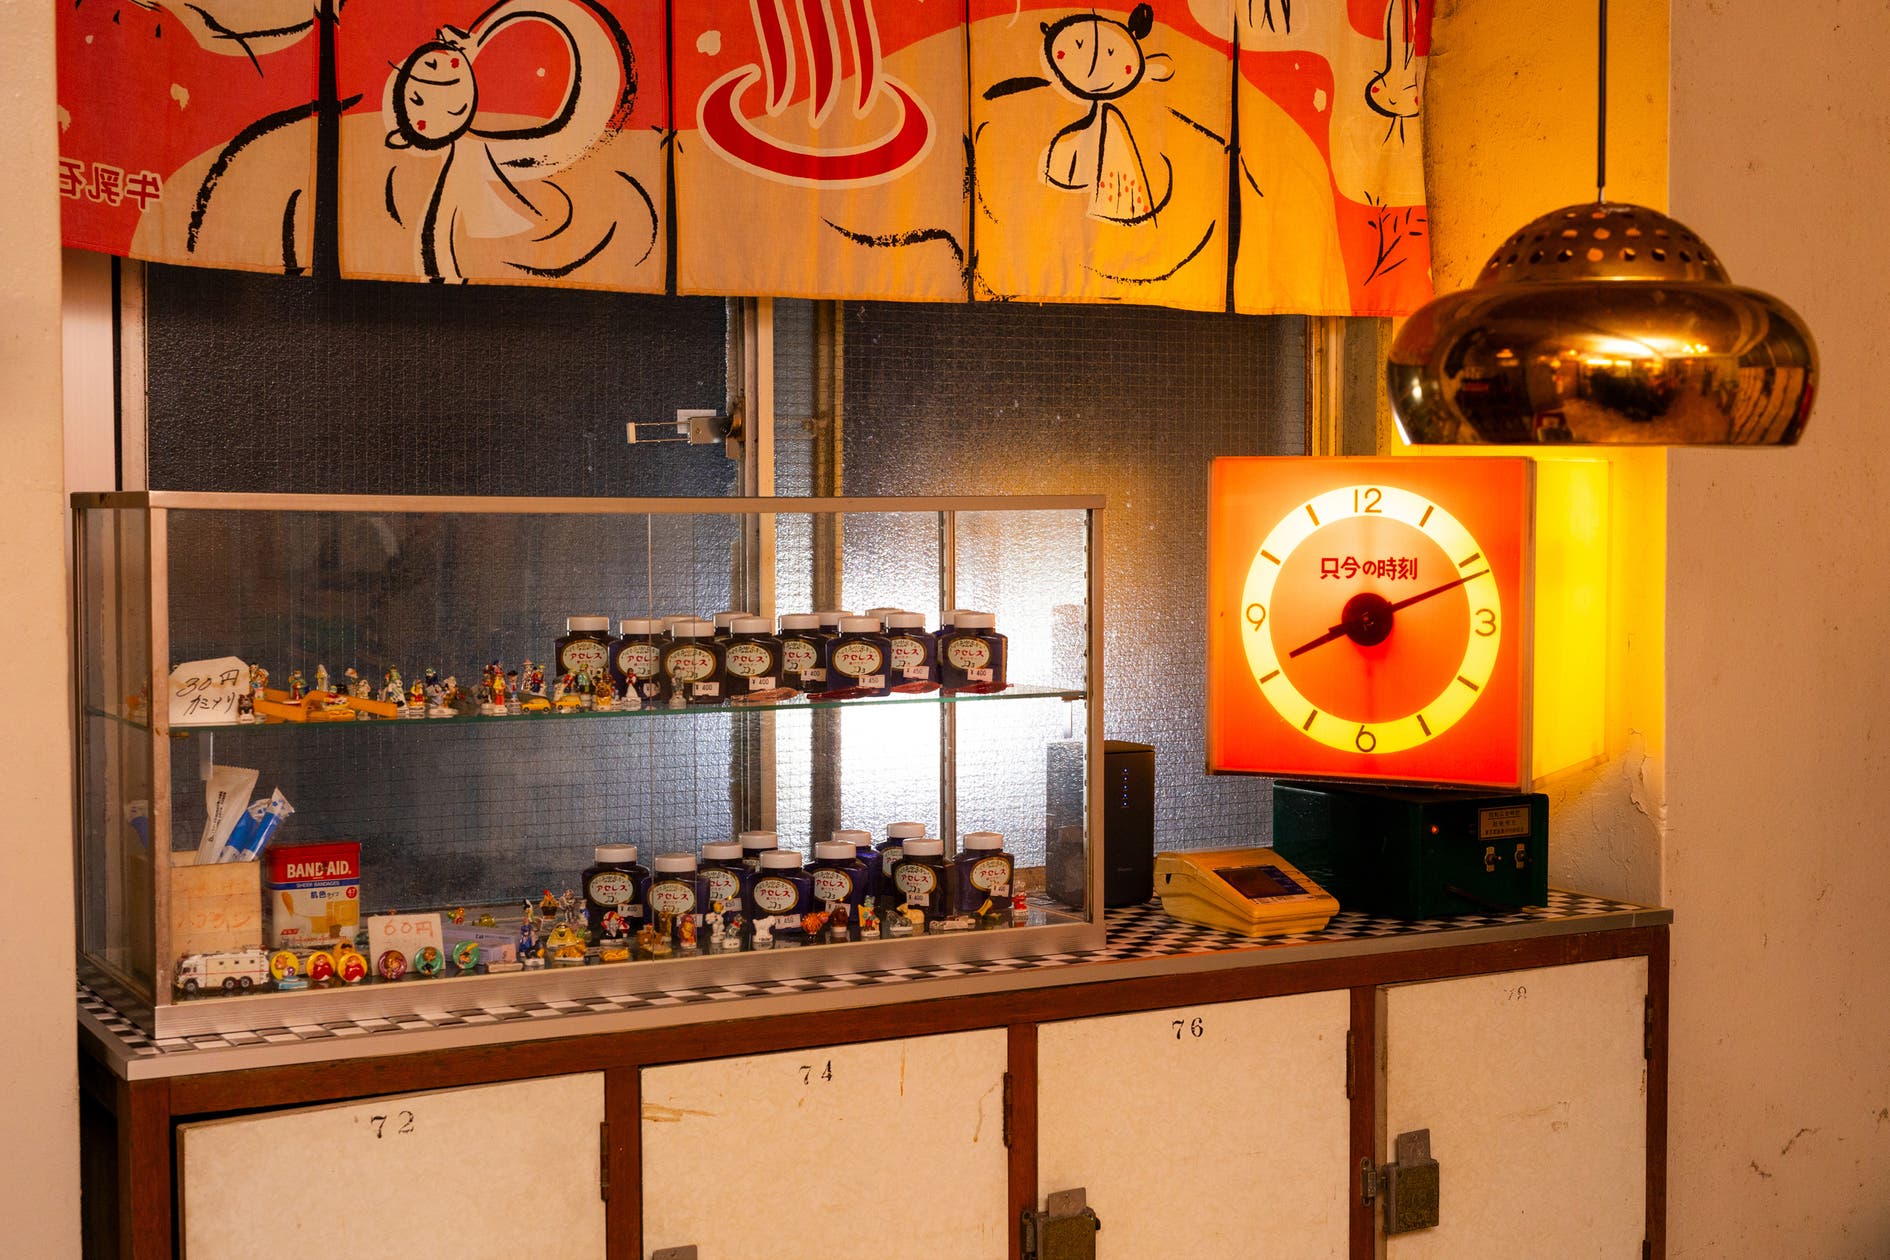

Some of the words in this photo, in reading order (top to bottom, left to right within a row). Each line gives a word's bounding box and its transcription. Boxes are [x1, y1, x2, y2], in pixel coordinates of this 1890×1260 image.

[1354, 488, 1382, 513] 12
[1320, 556, 1418, 580] 只今の時刻
[1246, 603, 1266, 631] 9
[1475, 608, 1497, 637] 3
[1355, 725, 1377, 753] 6
[1172, 1017, 1204, 1040] 76
[799, 1060, 833, 1085] 74
[371, 1110, 414, 1139] 72
